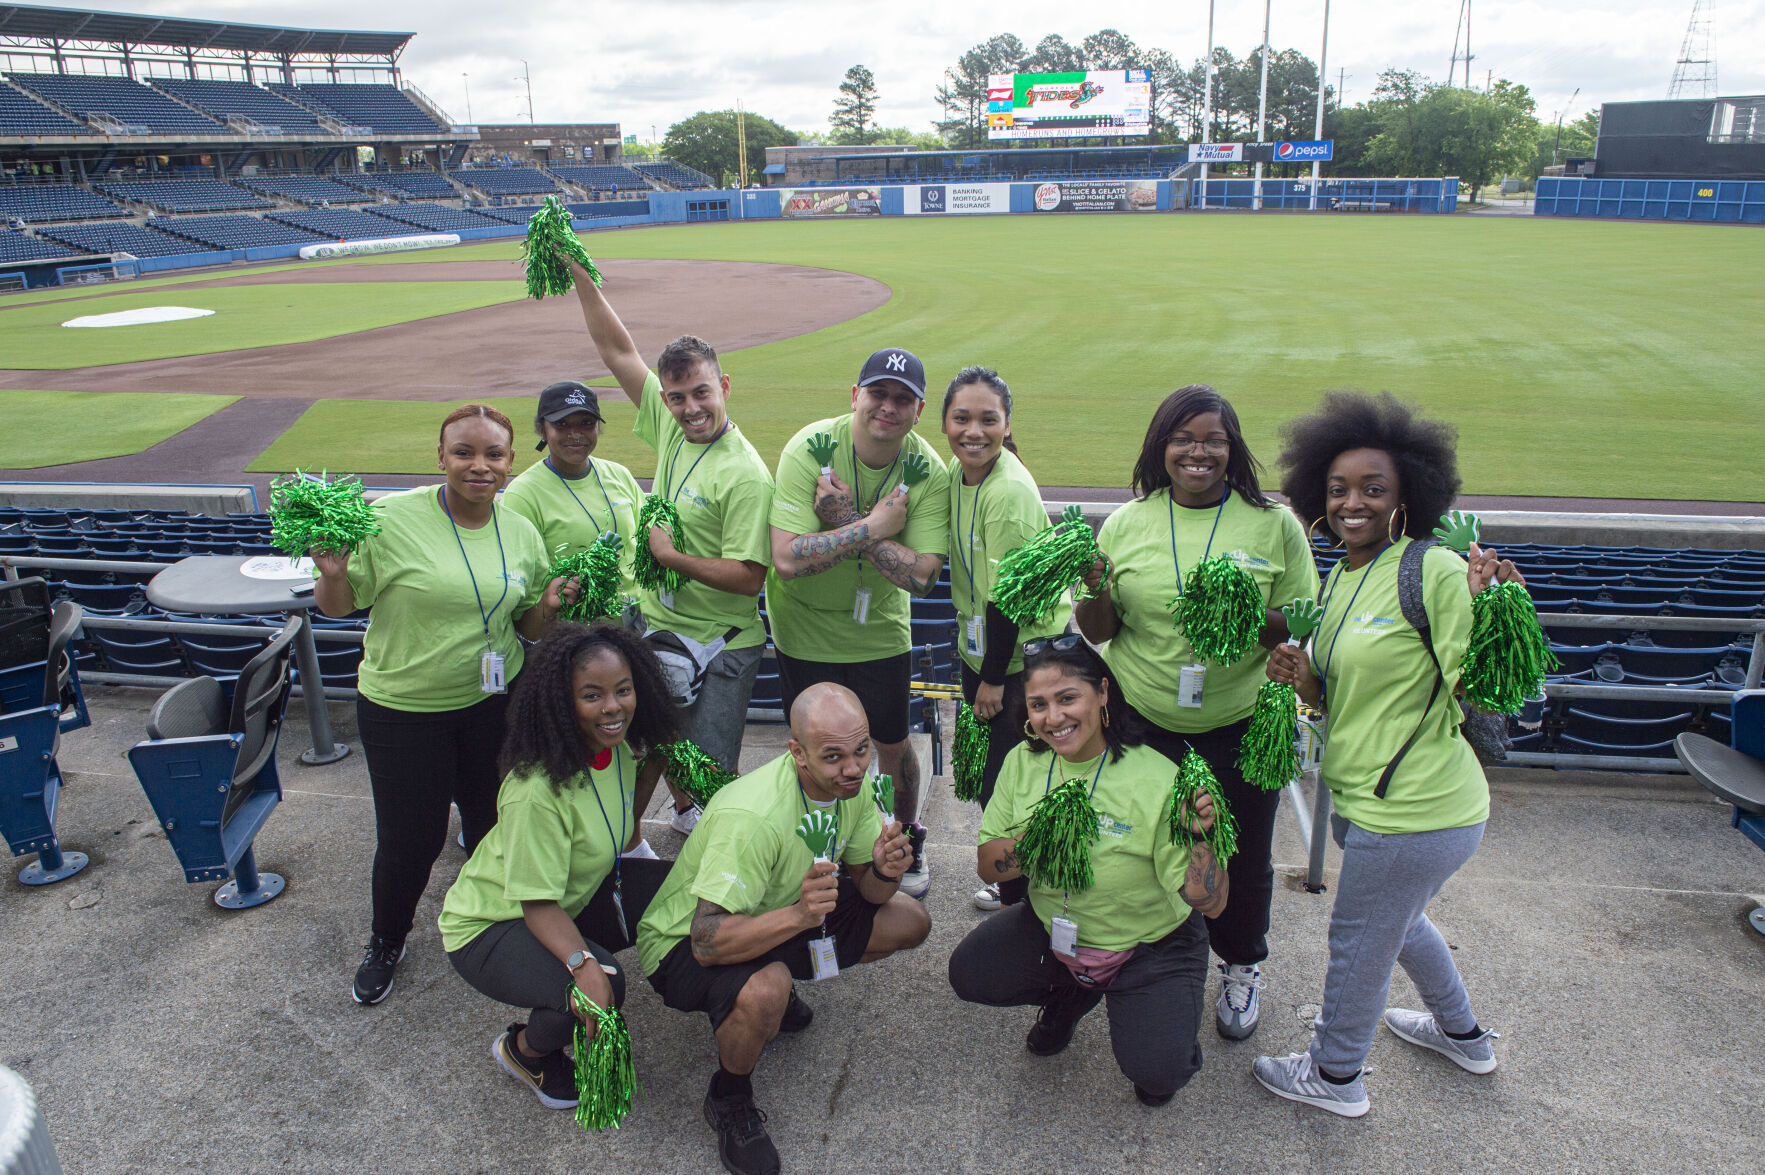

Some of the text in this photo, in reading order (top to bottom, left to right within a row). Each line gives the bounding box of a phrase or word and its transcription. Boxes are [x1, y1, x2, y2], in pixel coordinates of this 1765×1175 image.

[1026, 88, 1081, 105] TIDES
[1057, 128, 1073, 137] AND
[1198, 144, 1219, 152] Navy
[1295, 144, 1328, 157] pepsi
[1204, 151, 1234, 159] Mutual
[1293, 184, 1306, 192] 375
[1697, 188, 1714, 197] 400
